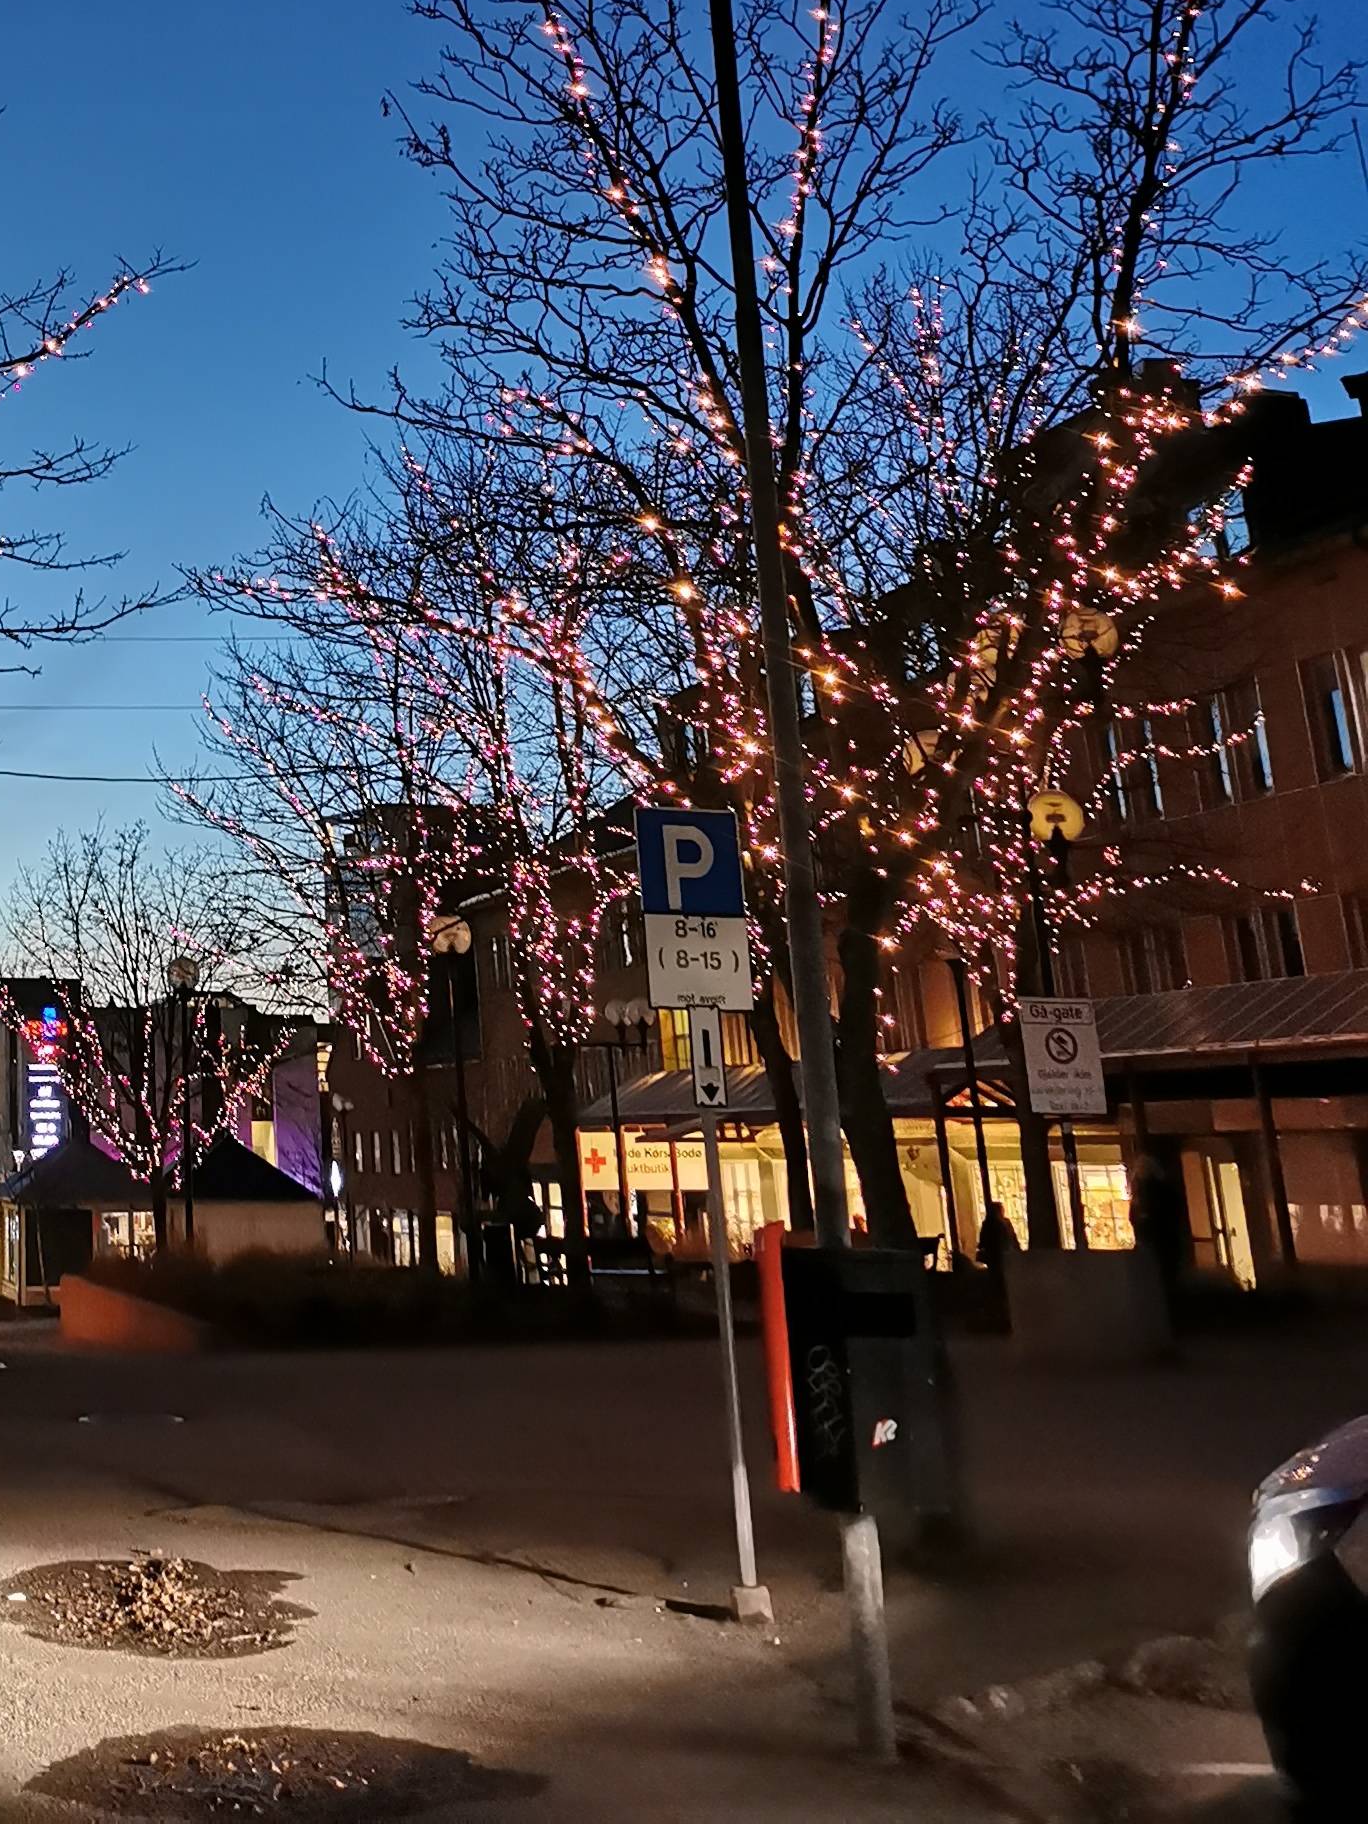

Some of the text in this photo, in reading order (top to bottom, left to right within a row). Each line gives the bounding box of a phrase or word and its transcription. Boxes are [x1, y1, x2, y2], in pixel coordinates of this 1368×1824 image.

[662, 824, 714, 910] P
[675, 919, 717, 939] 8-16
[1030, 1004, 1083, 1022] Gå-gate
